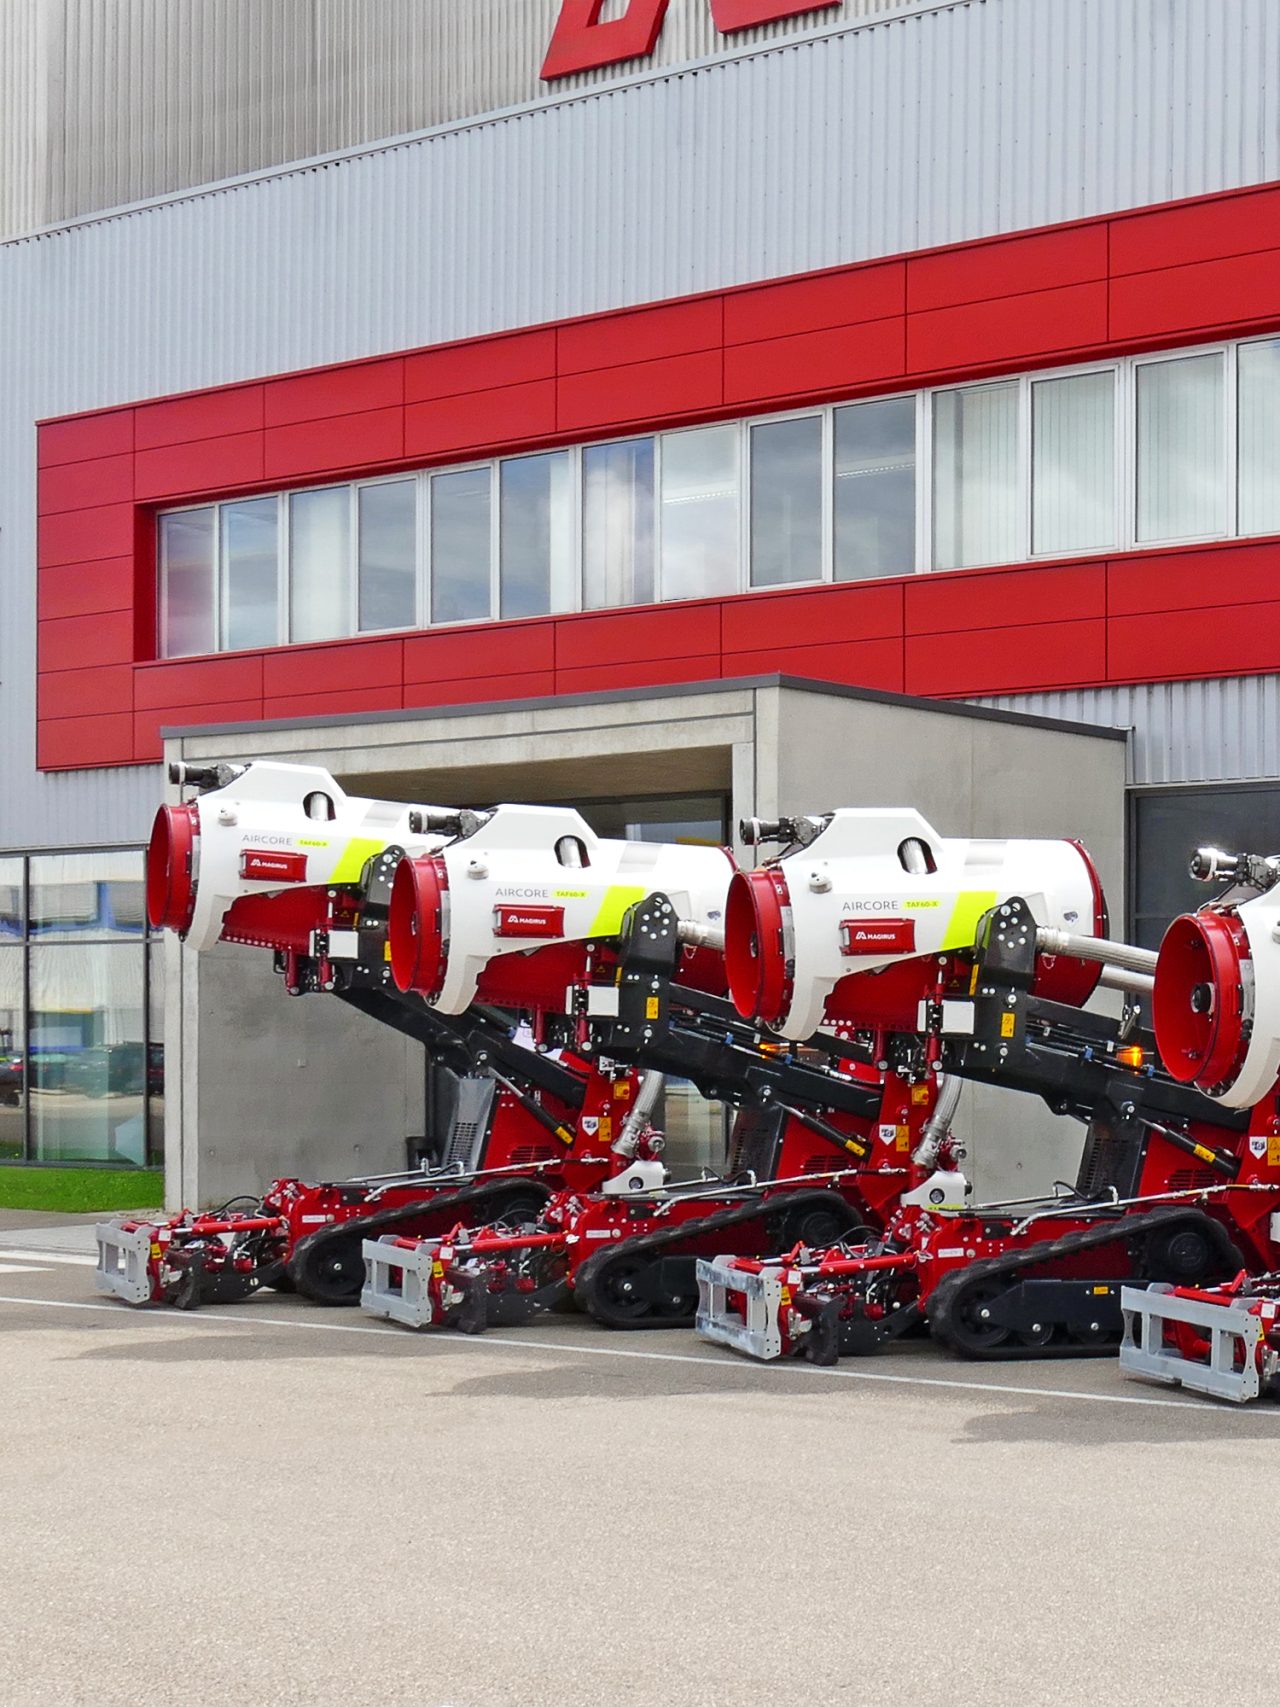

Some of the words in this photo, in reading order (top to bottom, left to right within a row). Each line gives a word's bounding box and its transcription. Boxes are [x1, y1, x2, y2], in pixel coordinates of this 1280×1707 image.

[242, 834, 293, 846] AIRCORE
[495, 888, 549, 898] AIRCORE
[842, 901, 899, 911] AIRCORE
